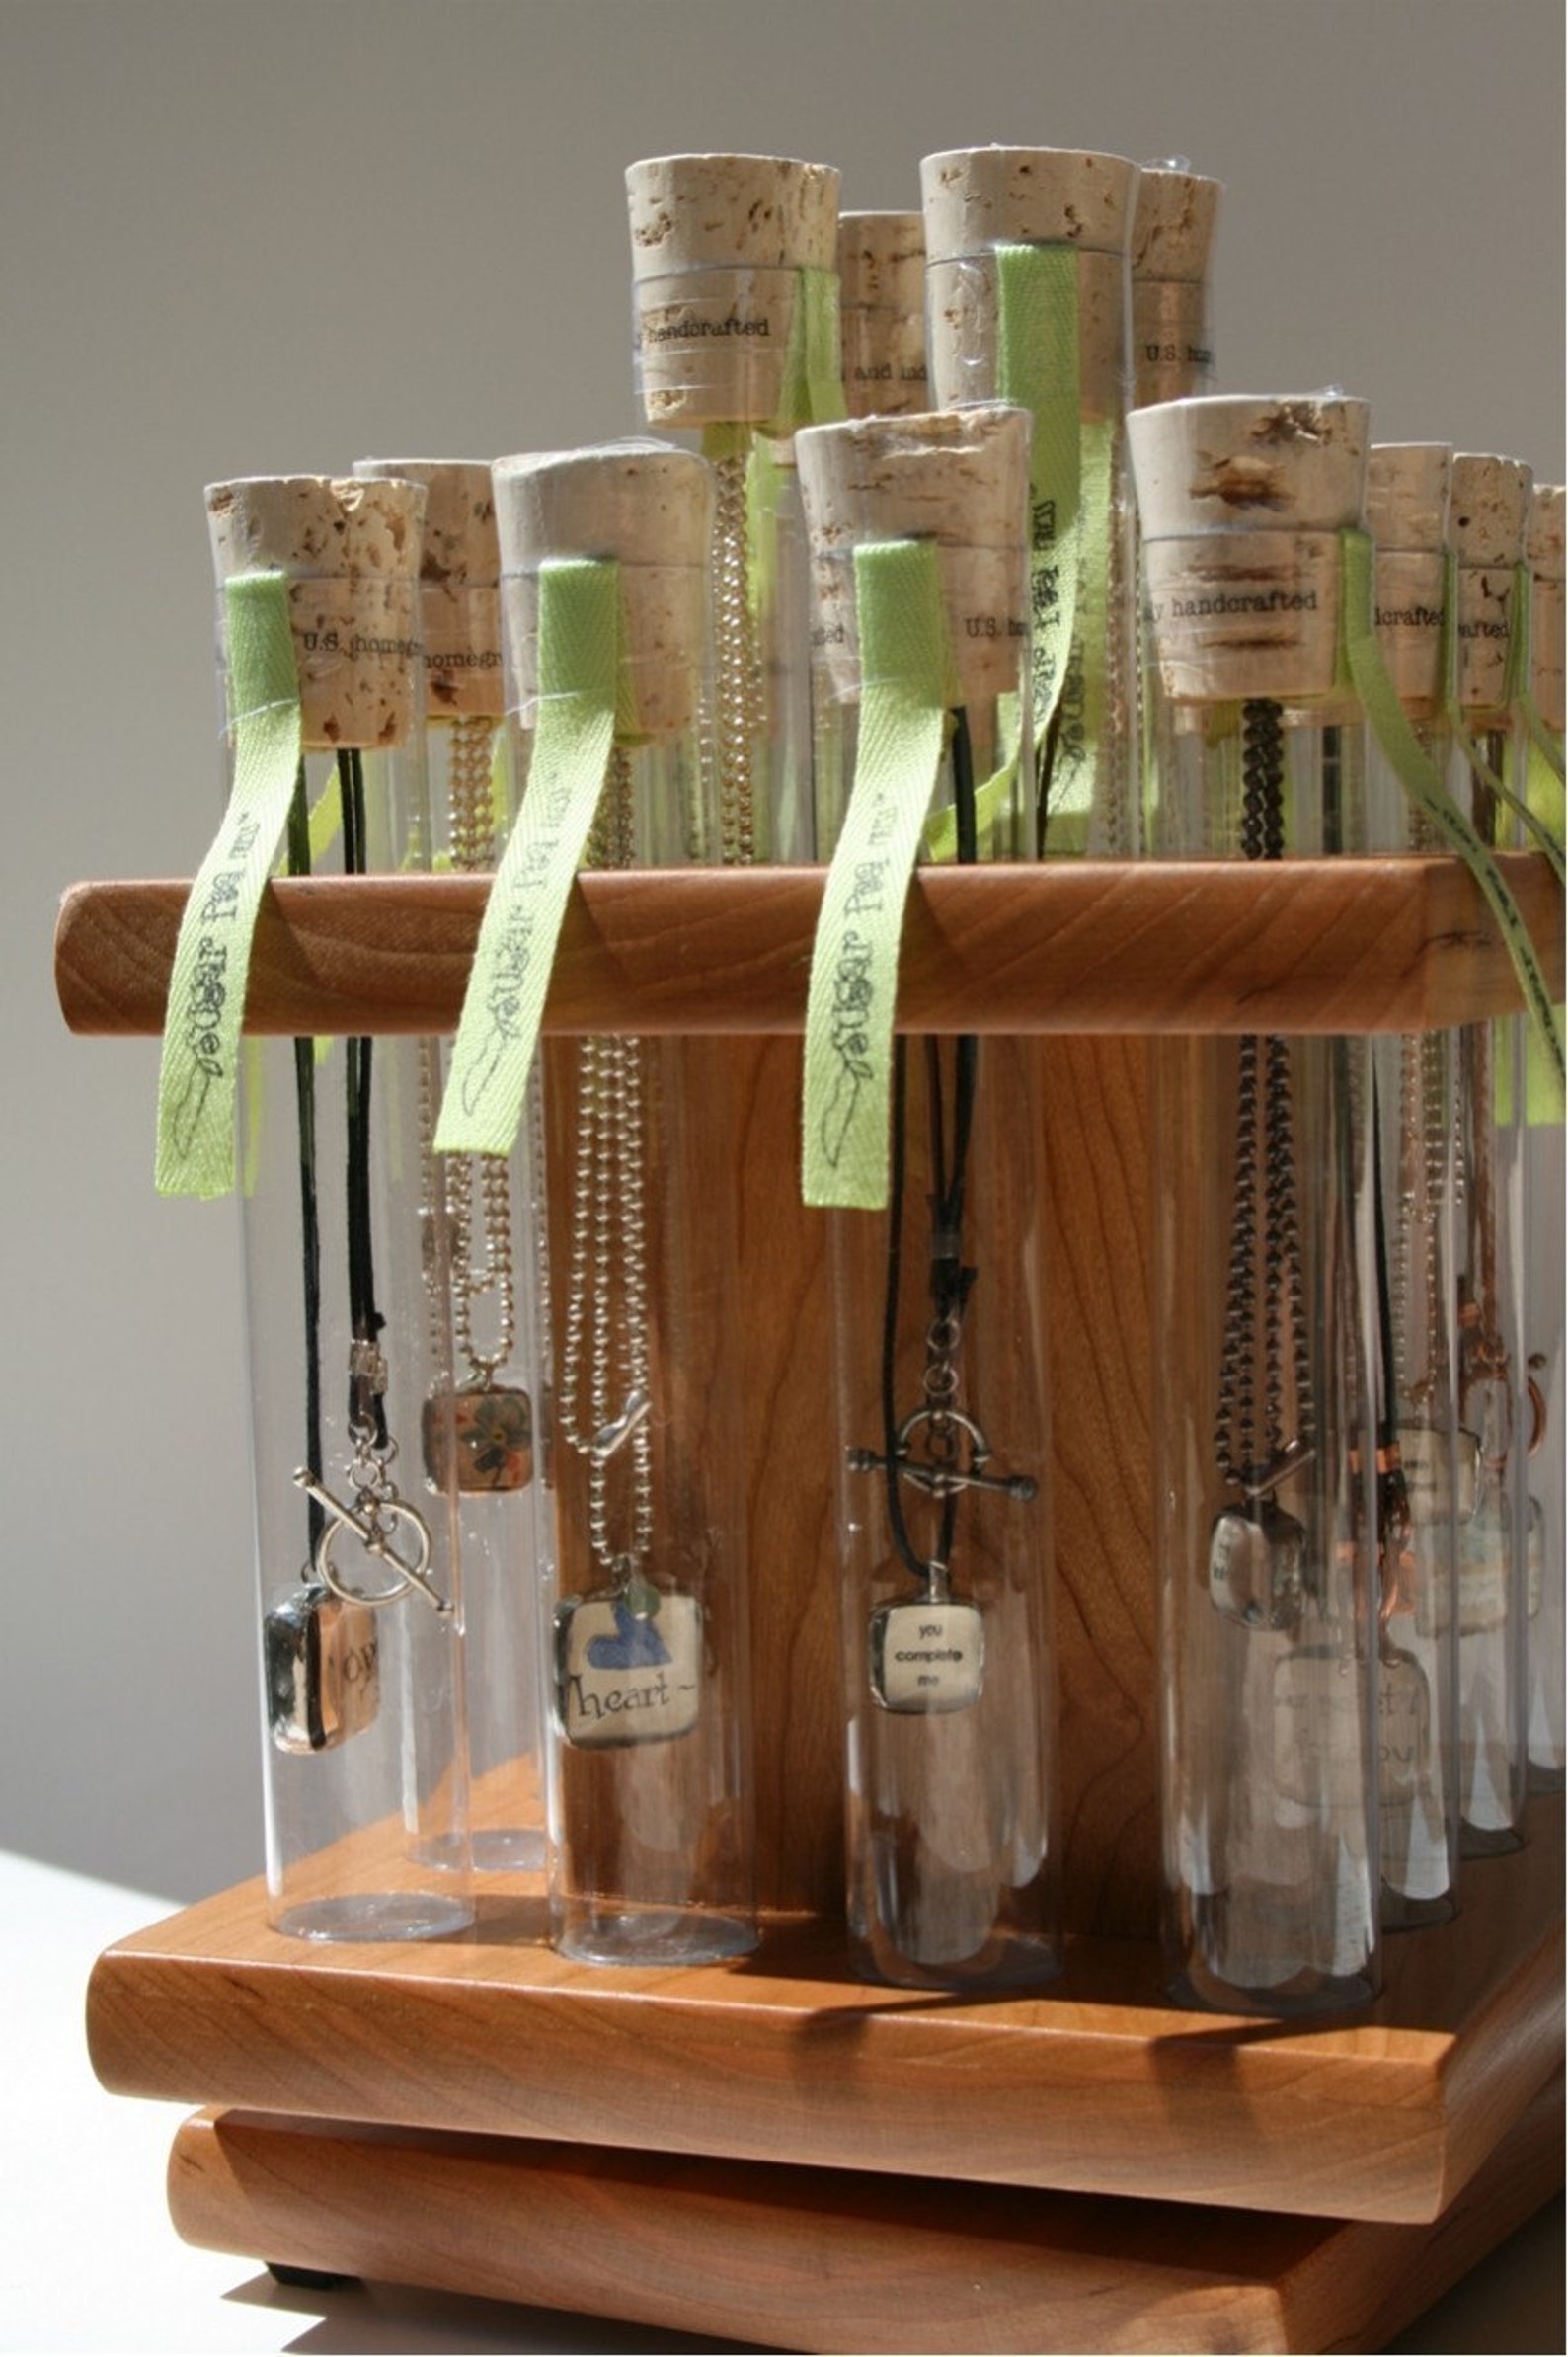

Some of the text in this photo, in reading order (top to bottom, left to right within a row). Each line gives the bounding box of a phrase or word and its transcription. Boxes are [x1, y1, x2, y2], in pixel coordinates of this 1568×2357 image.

[1171, 590, 1319, 619] handcrafted
[303, 631, 343, 653] U.S.
[918, 1624, 943, 1640] you
[569, 1671, 671, 1720] heart
